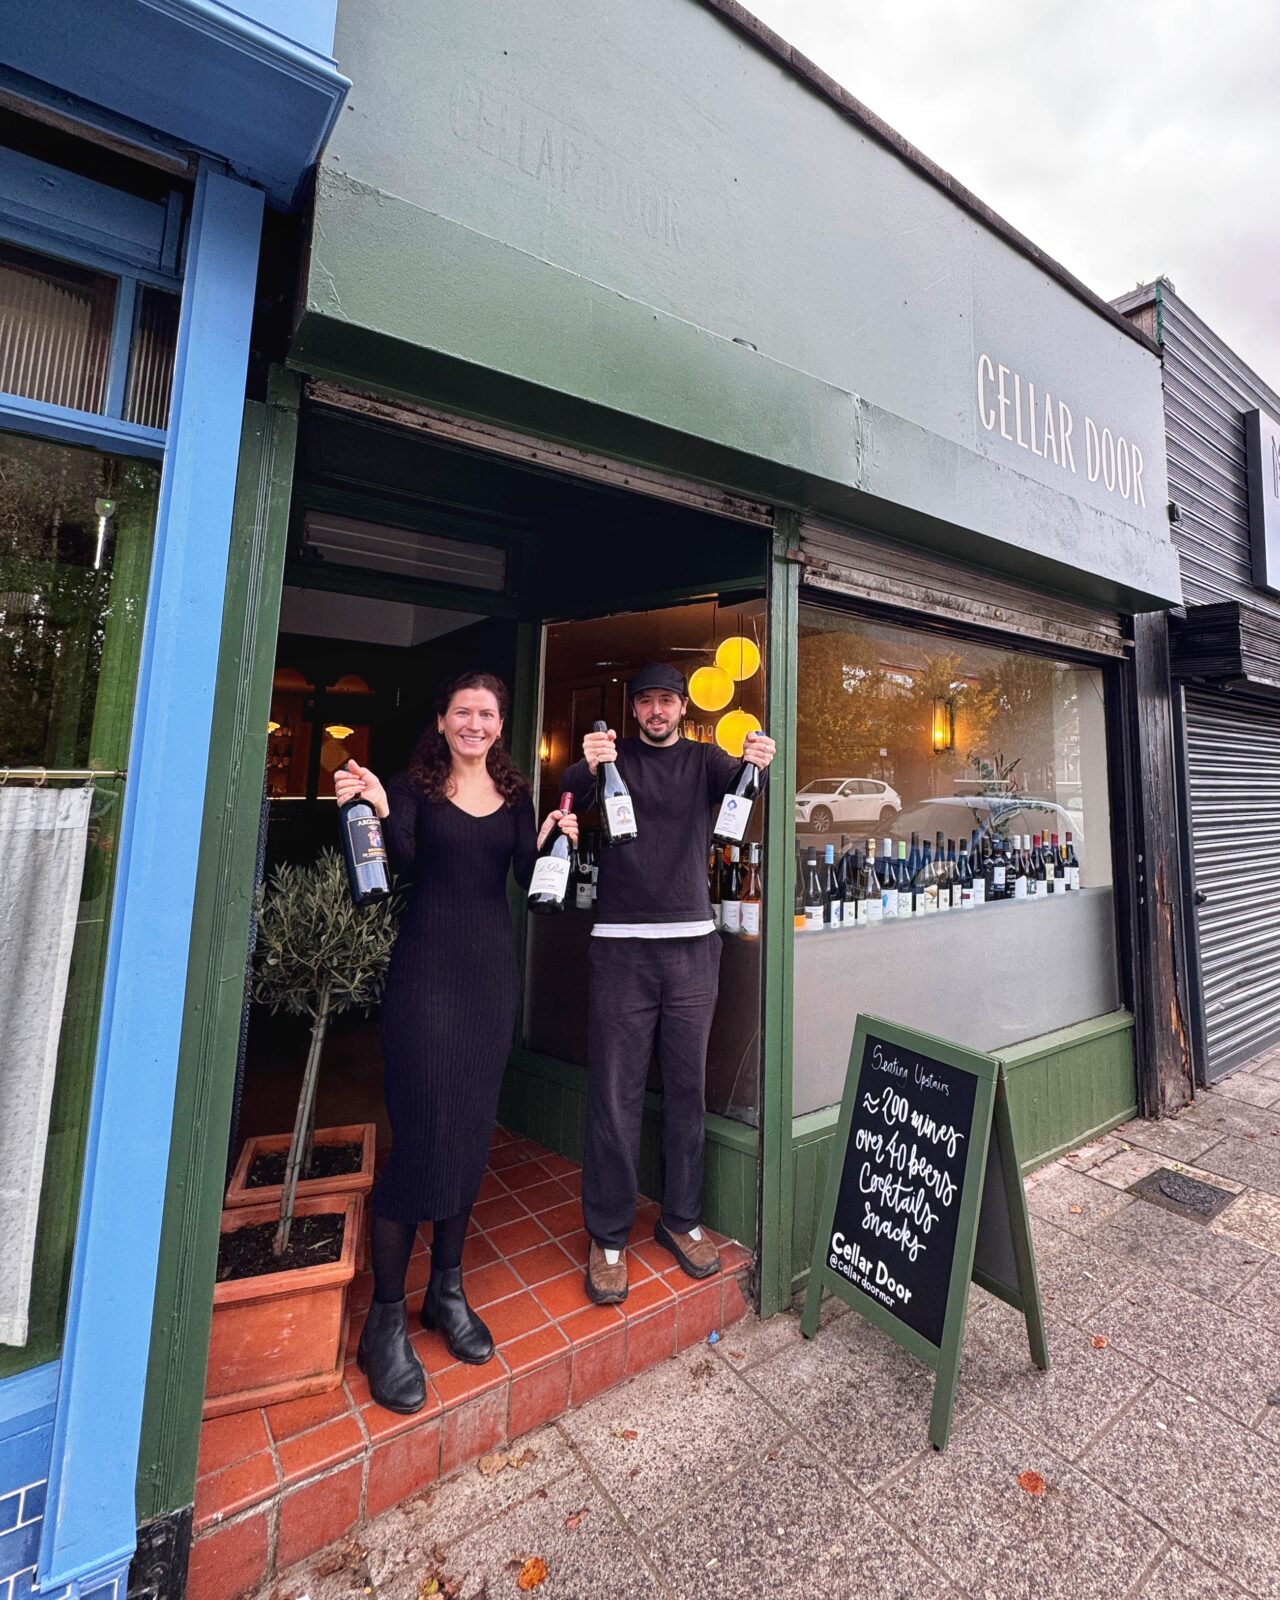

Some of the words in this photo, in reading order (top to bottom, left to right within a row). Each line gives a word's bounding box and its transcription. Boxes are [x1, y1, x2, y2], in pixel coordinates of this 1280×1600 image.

[977, 353, 1077, 473] CELLAR
[1085, 416, 1146, 508] DOOR
[871, 1044, 909, 1088] Seating
[914, 1063, 950, 1097] Upstairs
[856, 1129, 885, 1163] over
[885, 1130, 907, 1171] 40
[908, 1144, 958, 1207] beers
[910, 1110, 965, 1158] wines
[859, 1162, 940, 1234] Cocktails
[829, 1253, 896, 1308] @cellardoormcr
[831, 1232, 874, 1276] Cellar
[875, 1260, 912, 1304] Door
